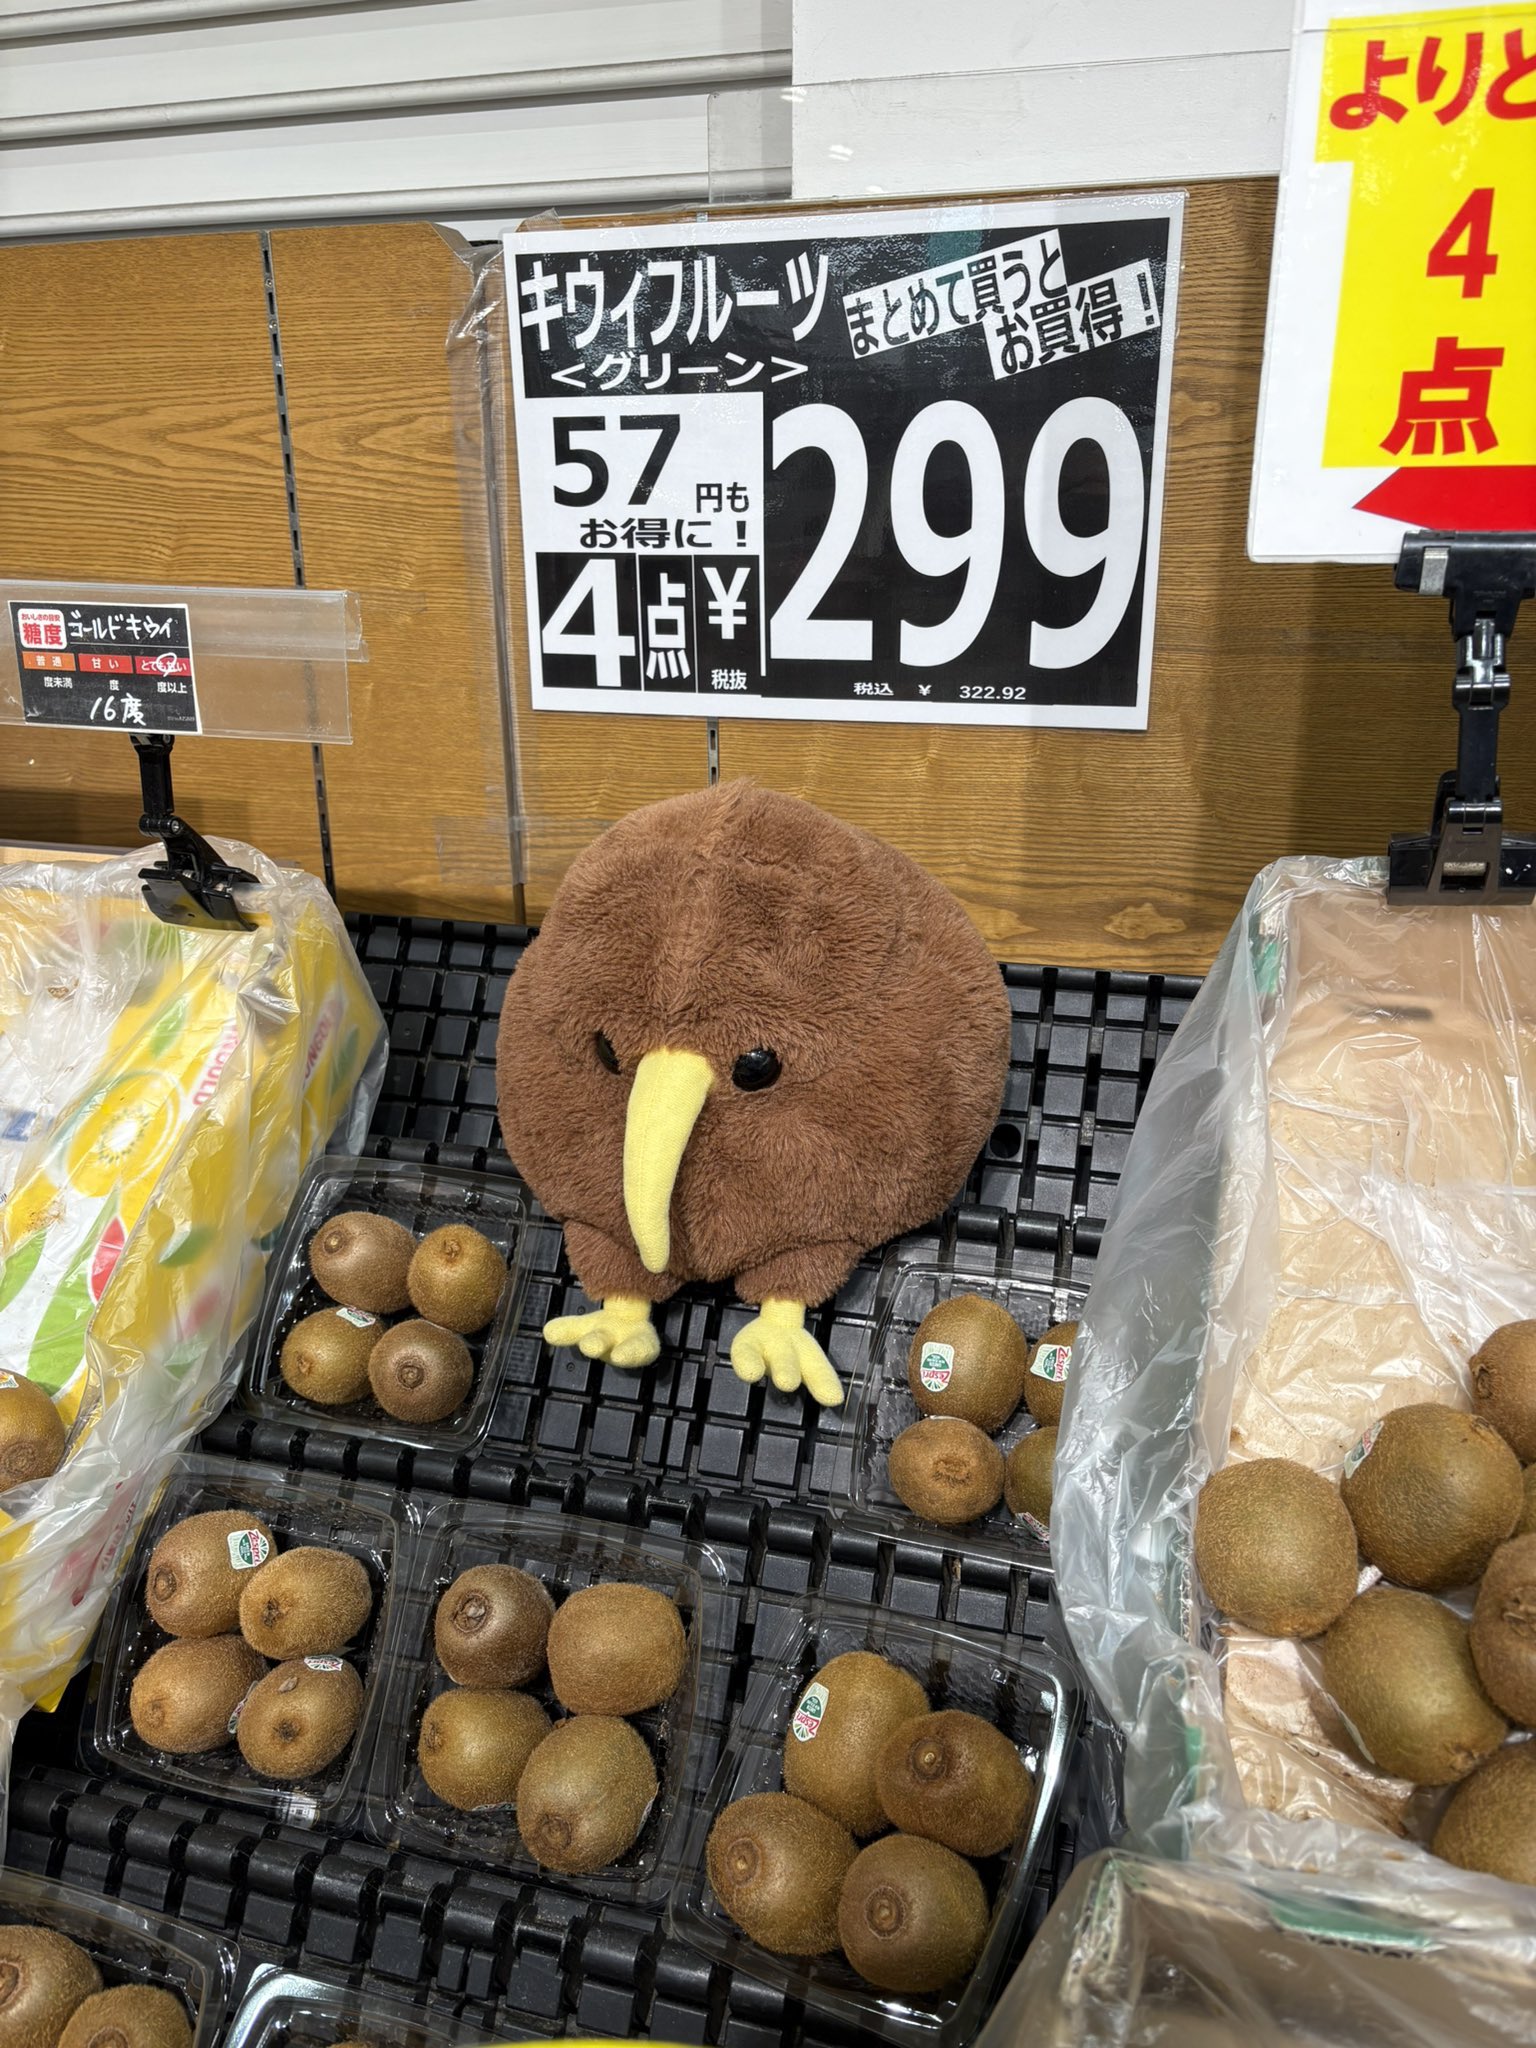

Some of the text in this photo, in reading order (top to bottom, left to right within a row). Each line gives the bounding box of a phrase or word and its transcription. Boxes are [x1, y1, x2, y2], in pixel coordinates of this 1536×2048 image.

[1426, 187, 1498, 299] 4
[846, 238, 1068, 356] まとめて買うと
[995, 272, 1156, 375] お買得！
[1378, 336, 1505, 456] 点
[580, 517, 747, 549] お得に！
[769, 396, 1143, 671] 299
[22, 623, 63, 646] 糖度
[36, 655, 63, 667] 普通
[91, 657, 120, 669] 甘い
[44, 677, 73, 689] 度未満
[109, 680, 120, 691] 度
[156, 682, 188, 694] 度以上
[711, 669, 748, 691] 税抜
[853, 682, 894, 696] 税込
[958, 685, 1026, 700] 322.92
[90, 692, 147, 726] 16度
[922, 1369, 950, 1384] Zespri
[247, 1529, 261, 1567] Zespri
